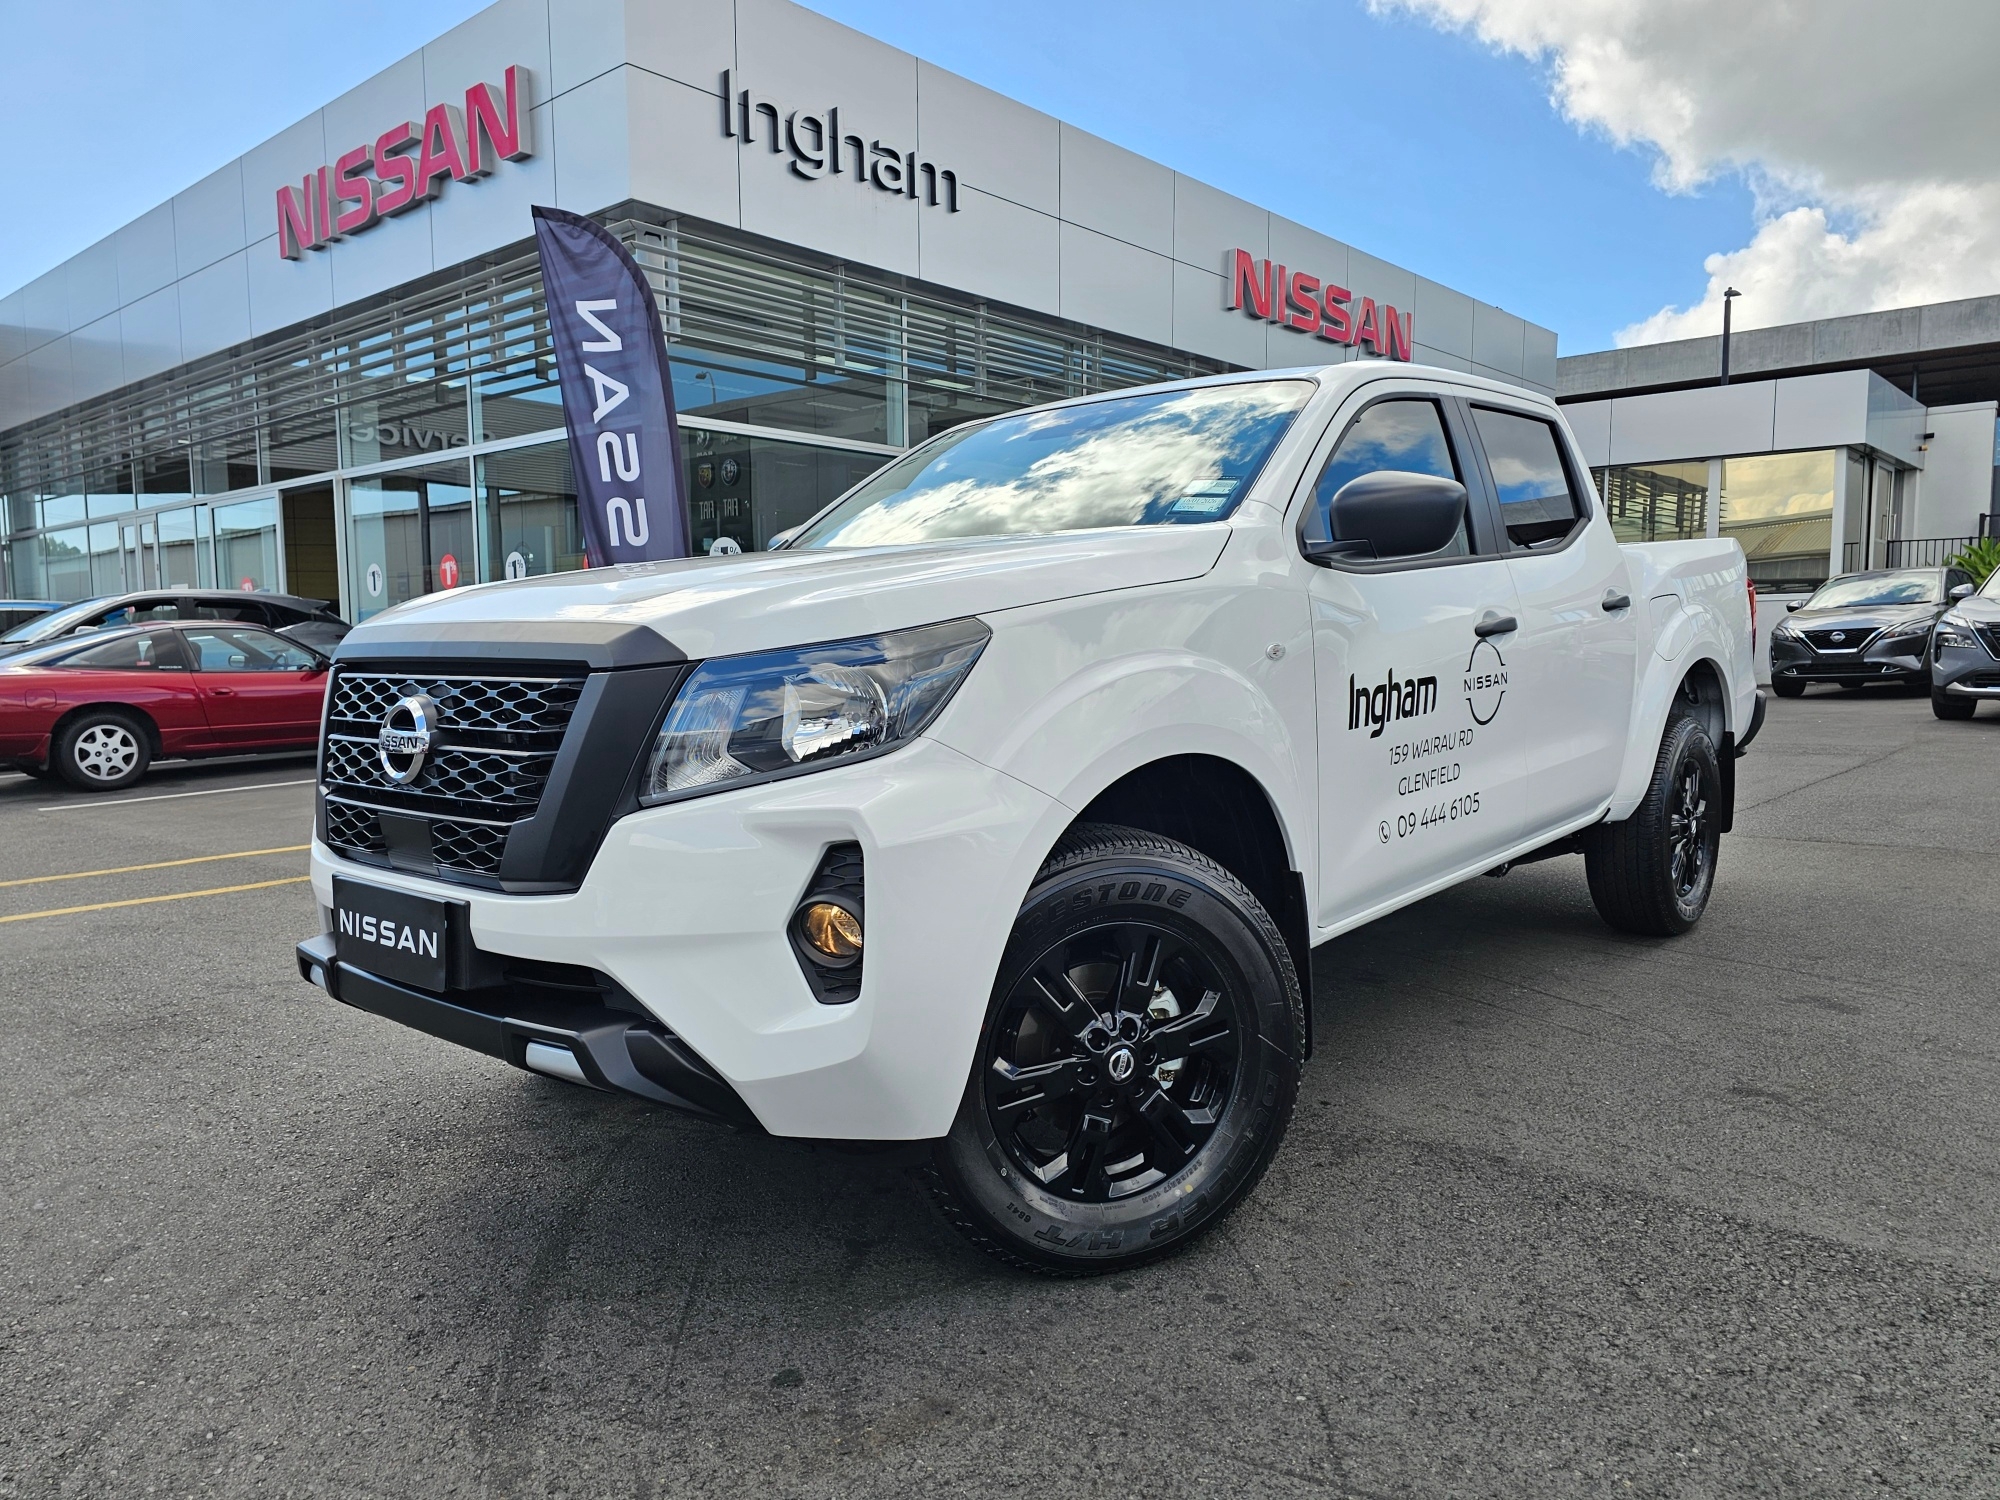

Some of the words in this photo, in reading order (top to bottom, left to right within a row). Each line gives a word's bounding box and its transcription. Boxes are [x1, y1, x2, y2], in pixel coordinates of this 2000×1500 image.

[276, 64, 530, 260] NISSAN
[721, 68, 961, 213] Ingham
[1229, 248, 1412, 362] NISSAN
[1348, 667, 1437, 739] Ingham
[1463, 672, 1508, 692] NISSAN
[380, 735, 418, 749] SSAN
[1389, 743, 1409, 765] 159
[1412, 732, 1456, 760] WAIRAU
[1458, 728, 1474, 748] RD
[1398, 763, 1461, 796] GLENFIELD
[1397, 812, 1417, 838] 09
[1420, 803, 1446, 830] 444
[1450, 792, 1480, 821] 6105
[339, 907, 438, 959] NISSAN
